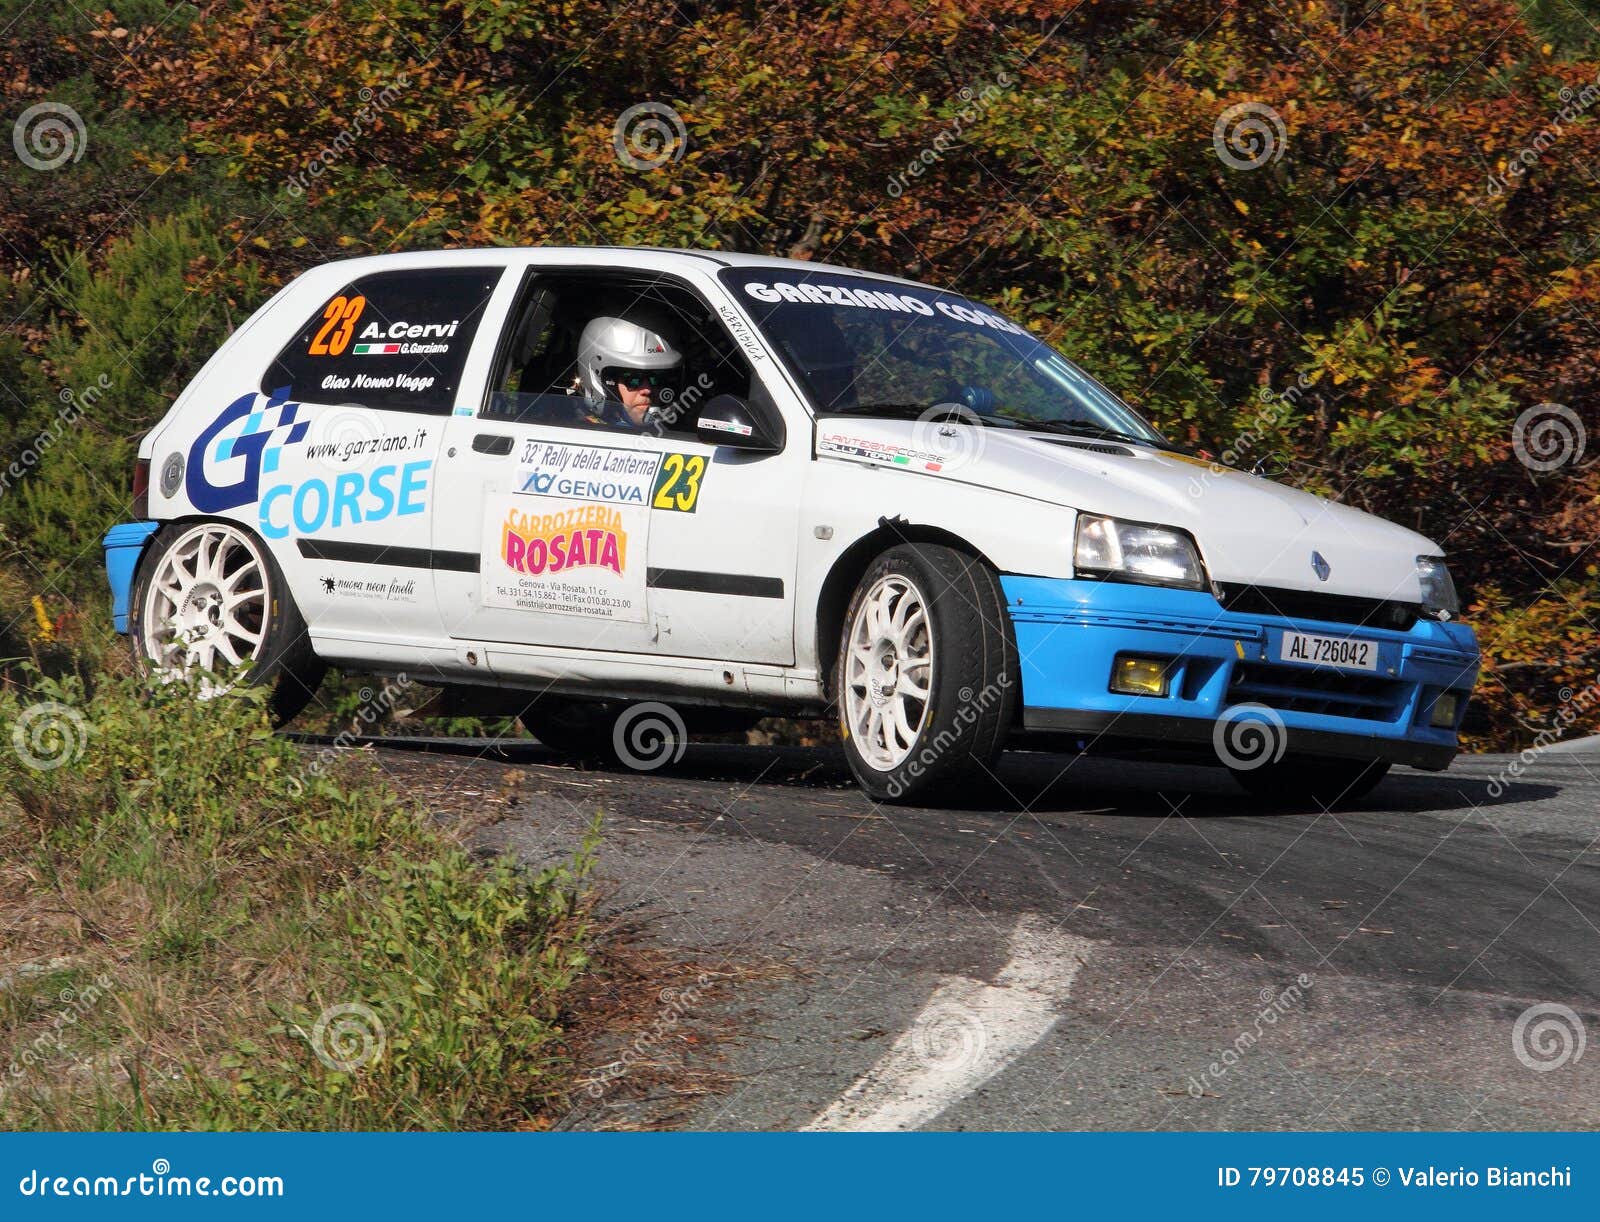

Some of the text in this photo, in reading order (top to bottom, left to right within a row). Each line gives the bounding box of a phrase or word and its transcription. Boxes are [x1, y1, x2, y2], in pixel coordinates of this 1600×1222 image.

[744, 282, 934, 317] GARZIANO
[307, 295, 367, 356] 23
[359, 320, 460, 339] A.Cervi
[400, 342, 449, 355] G.Garziano
[321, 374, 351, 390] Ciao
[351, 374, 395, 389] Nonno
[306, 428, 428, 463] www.garziano.it
[540, 445, 573, 473] Rally
[572, 448, 602, 471] della
[602, 450, 657, 477] Lanterna
[557, 479, 643, 501] GENOVA
[653, 452, 706, 512] 23
[258, 459, 433, 539] CORSE
[508, 505, 622, 534] CARROZZERIA
[506, 529, 621, 575] ROSATA
[518, 578, 546, 590] Genova
[550, 581, 562, 591] Via
[1289, 635, 1369, 666] AL 726042
